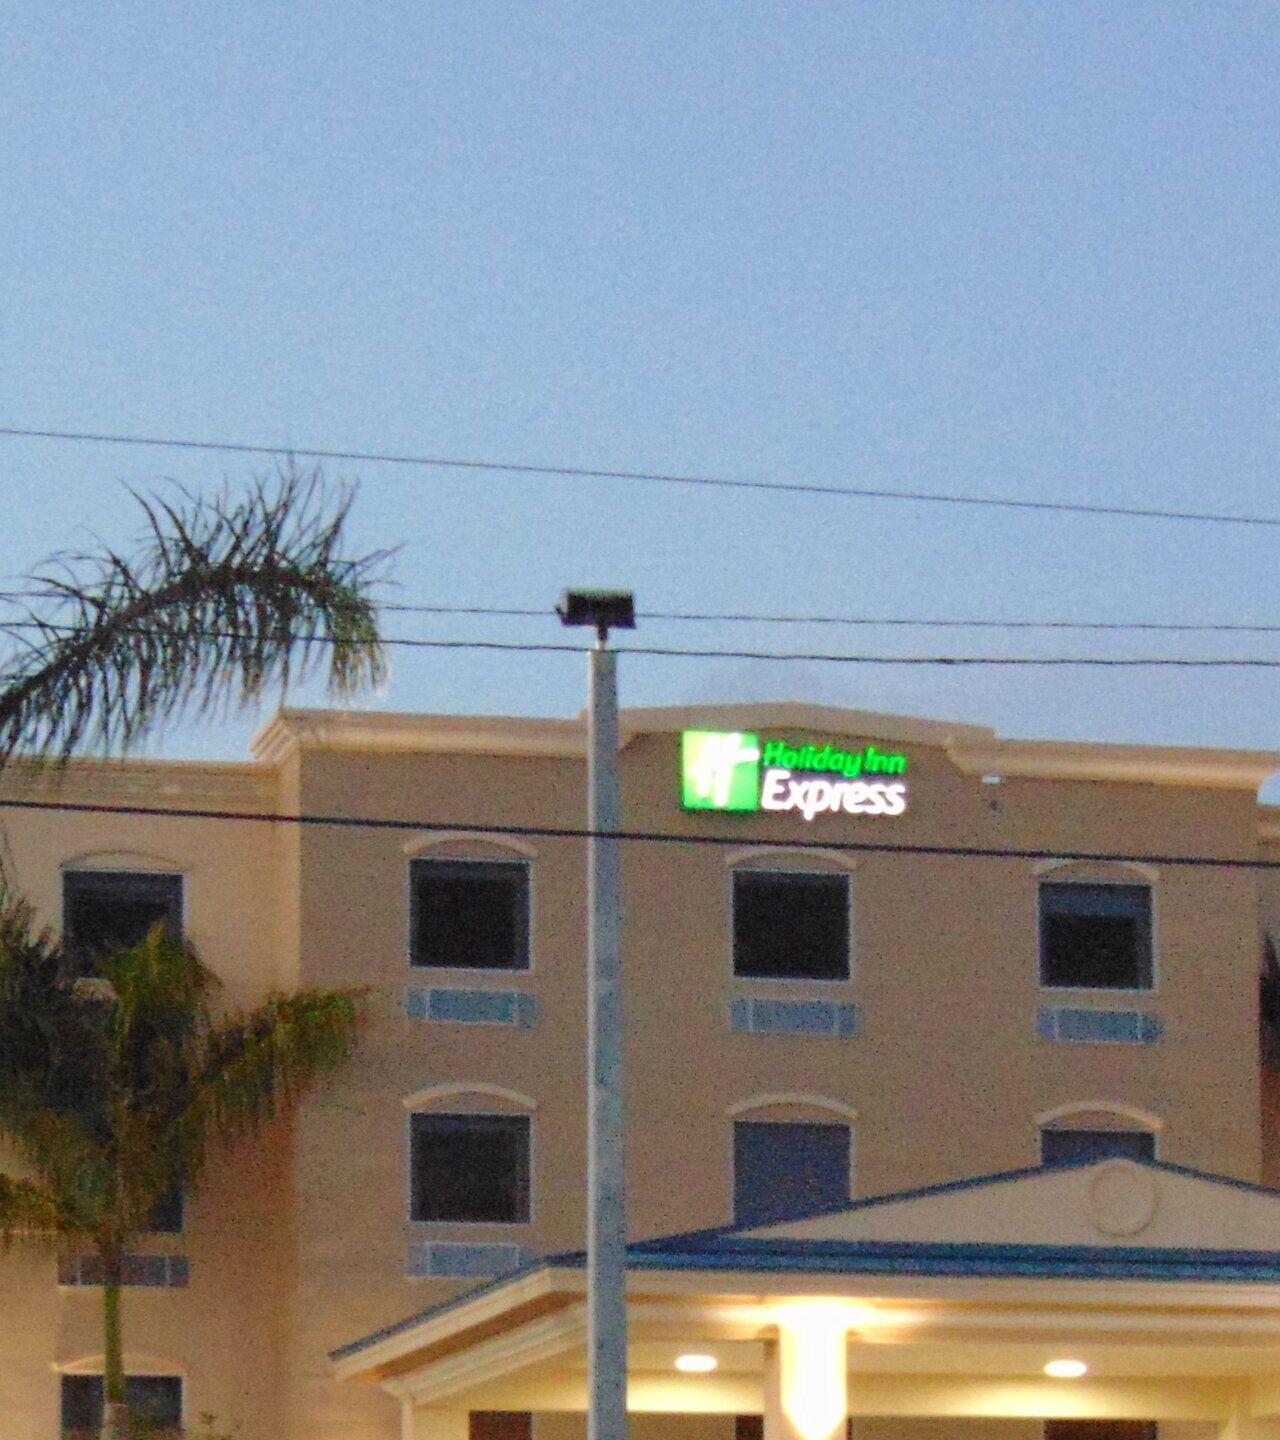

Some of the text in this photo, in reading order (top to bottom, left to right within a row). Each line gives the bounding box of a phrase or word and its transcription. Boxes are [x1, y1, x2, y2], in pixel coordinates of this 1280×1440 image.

[763, 741, 907, 777] Holiday Inn
[761, 769, 906, 821] Express
